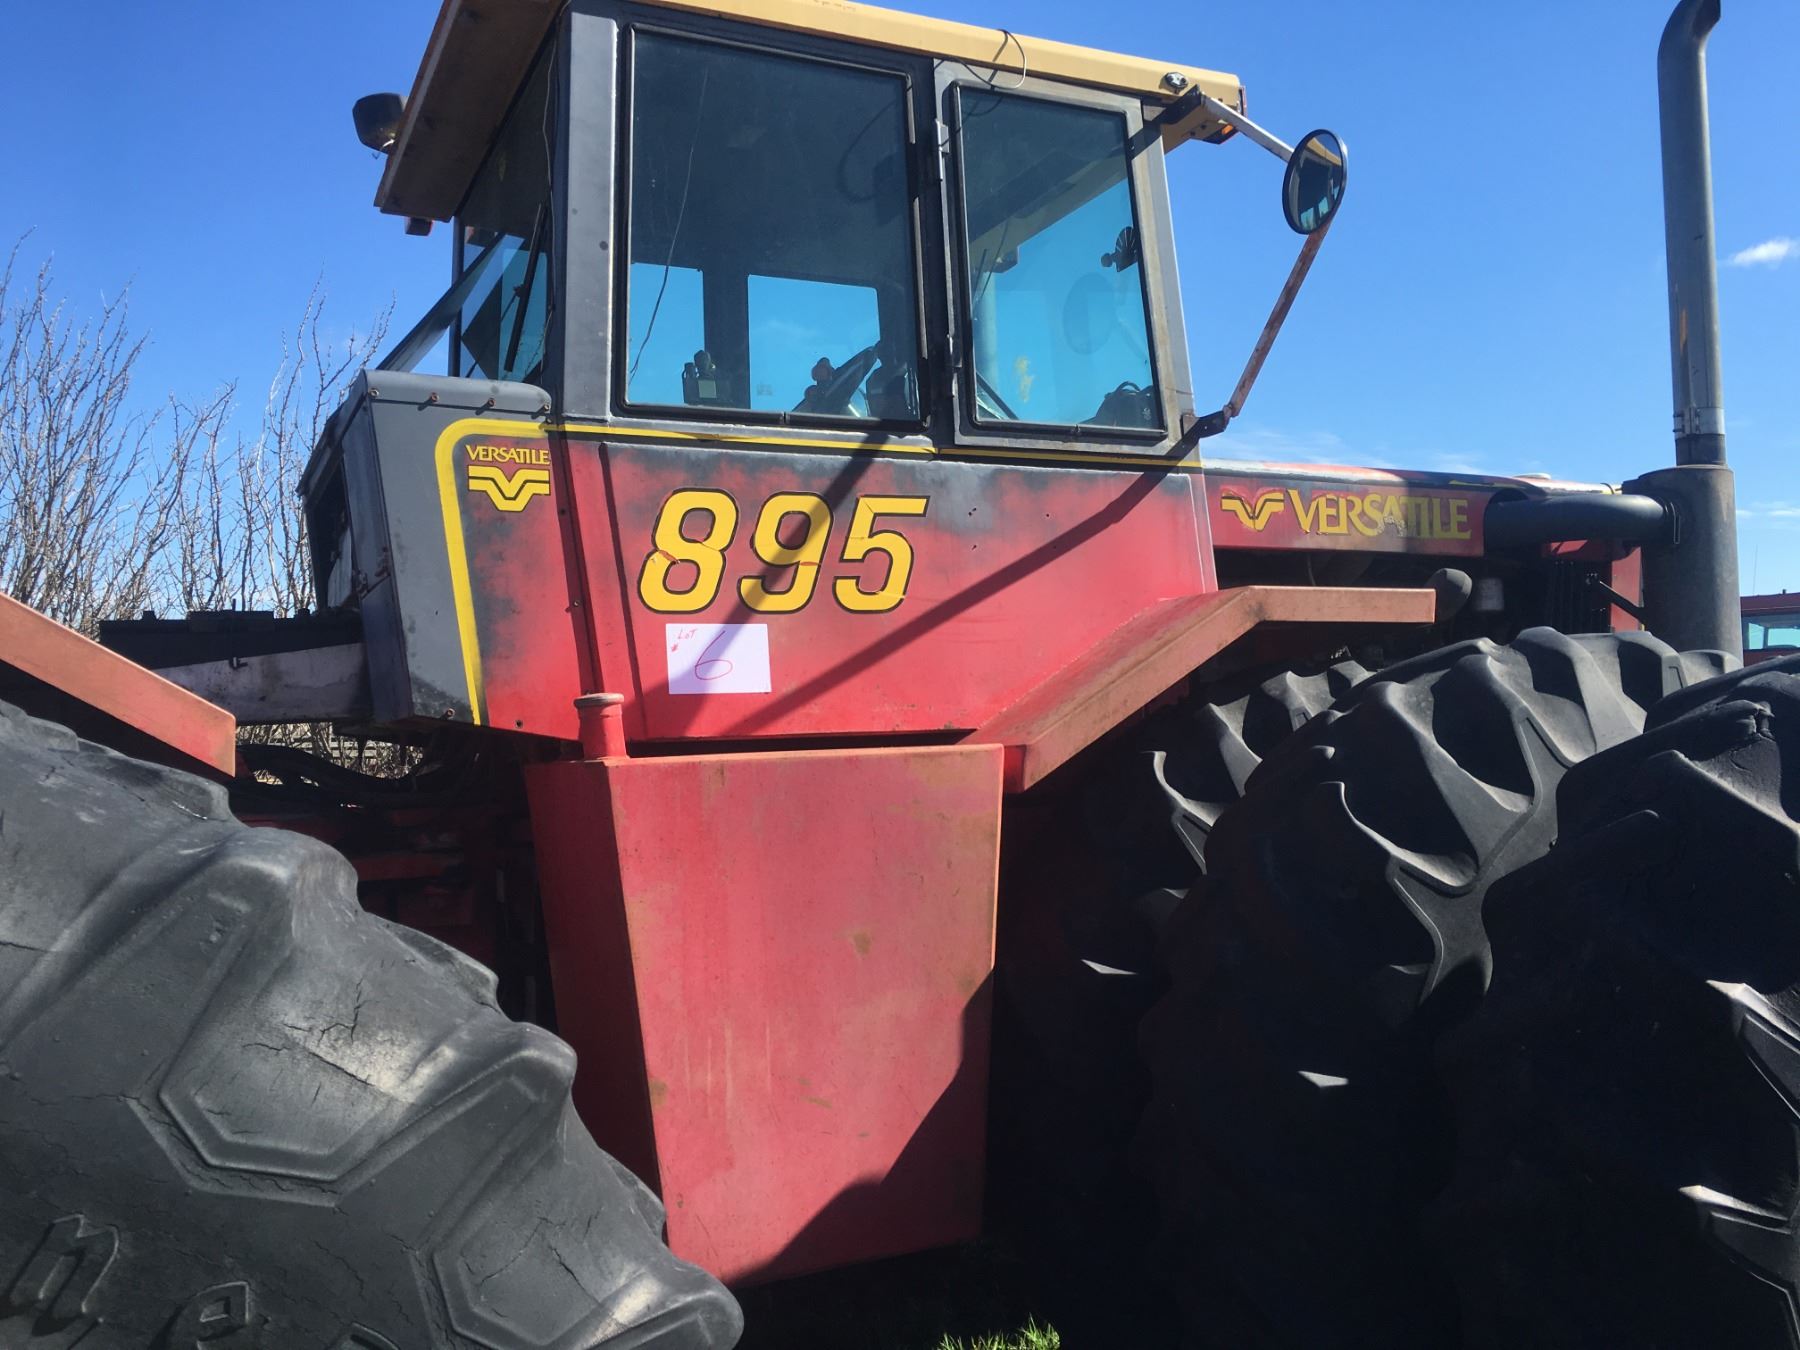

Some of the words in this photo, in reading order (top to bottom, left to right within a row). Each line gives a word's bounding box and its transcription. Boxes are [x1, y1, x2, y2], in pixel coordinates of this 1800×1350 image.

[465, 444, 551, 465] VERSATILE
[1286, 488, 1472, 539] VERSATILE
[637, 487, 931, 614] 895
[694, 630, 733, 681] 6
